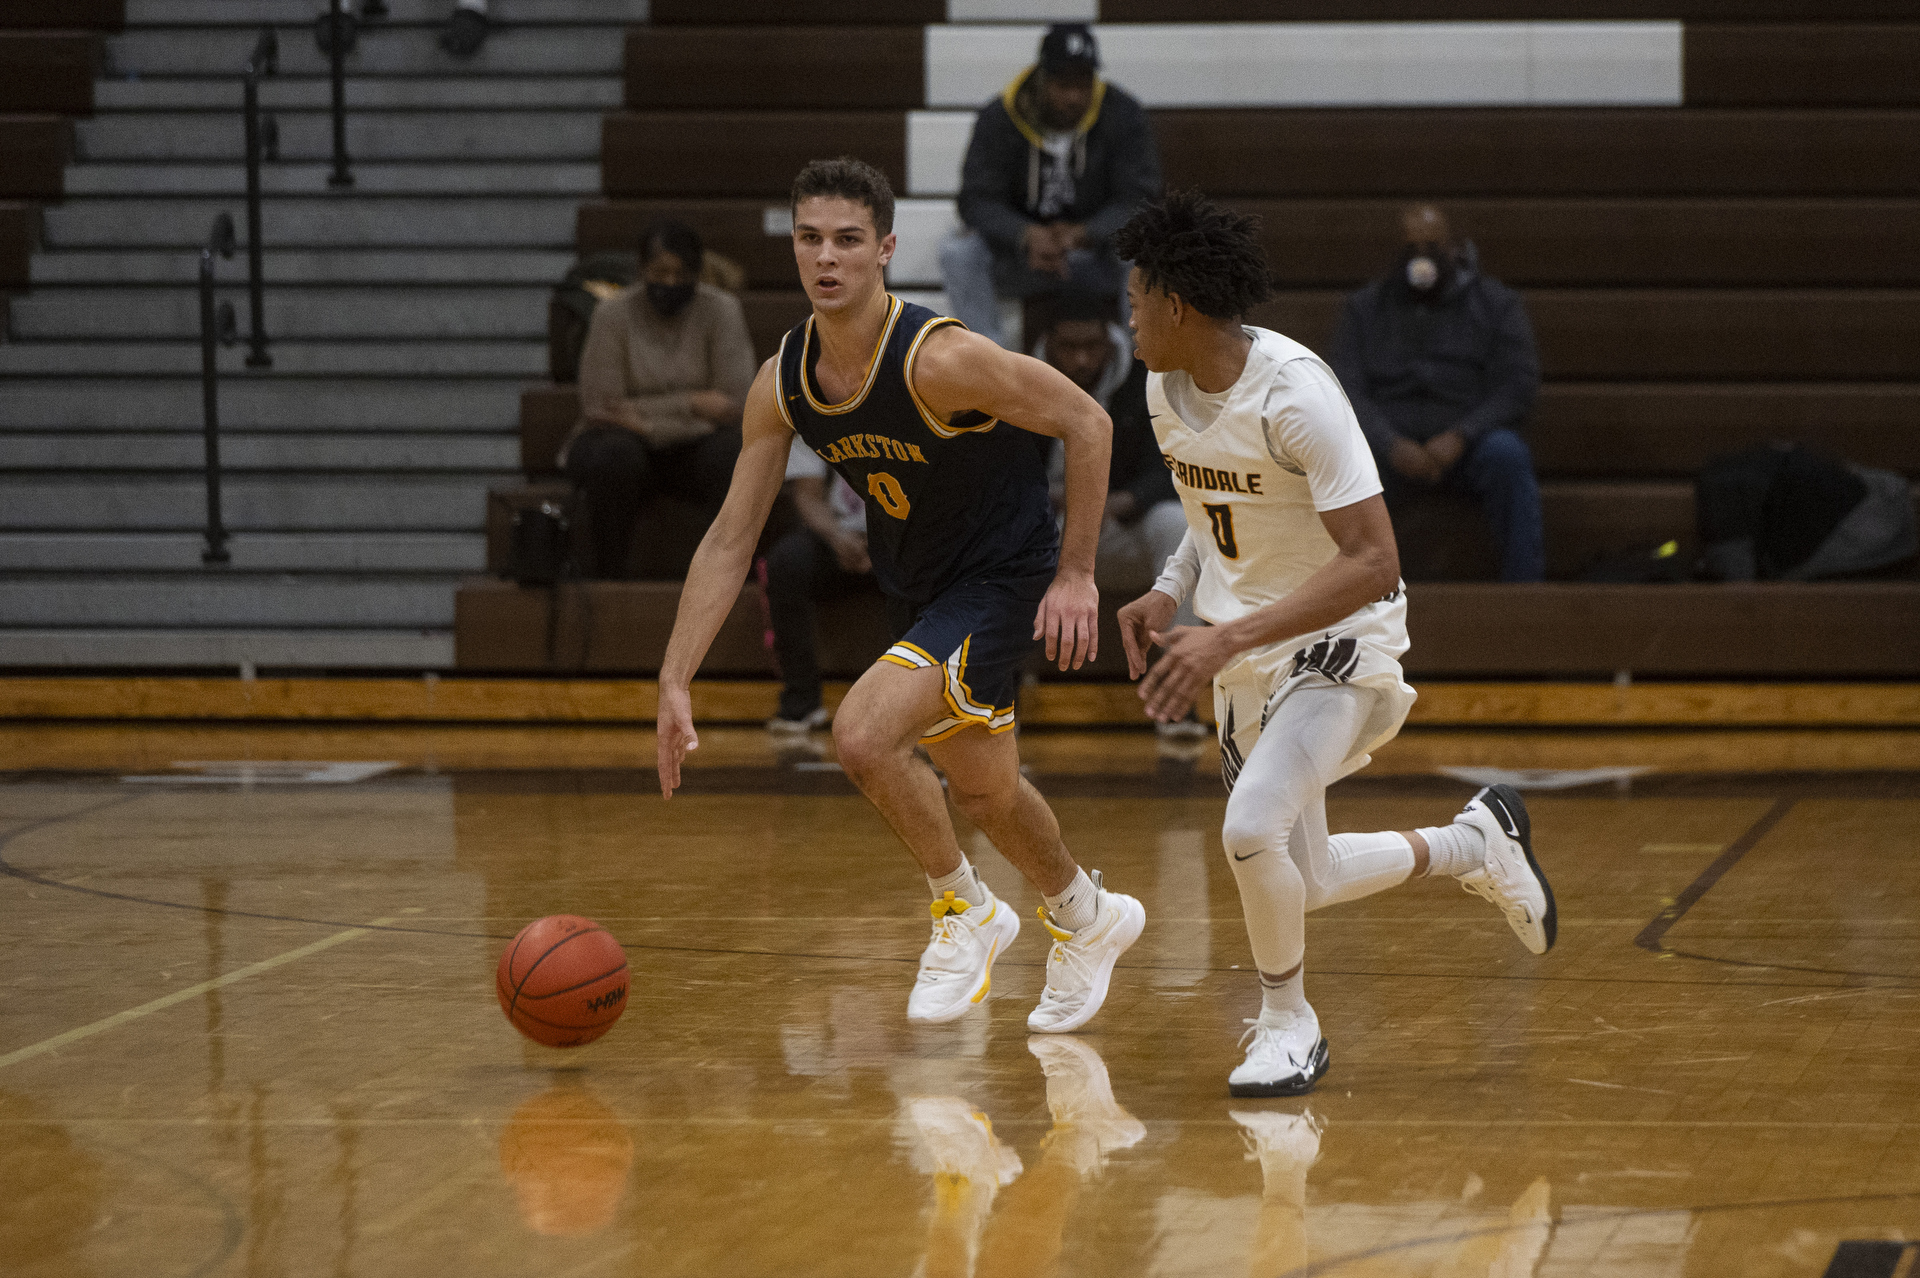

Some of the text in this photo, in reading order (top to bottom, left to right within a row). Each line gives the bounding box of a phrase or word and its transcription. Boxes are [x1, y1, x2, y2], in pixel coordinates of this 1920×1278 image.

[816, 433, 929, 464] LARKSTON
[867, 472, 910, 520] 0
[1202, 502, 1240, 560] 0
